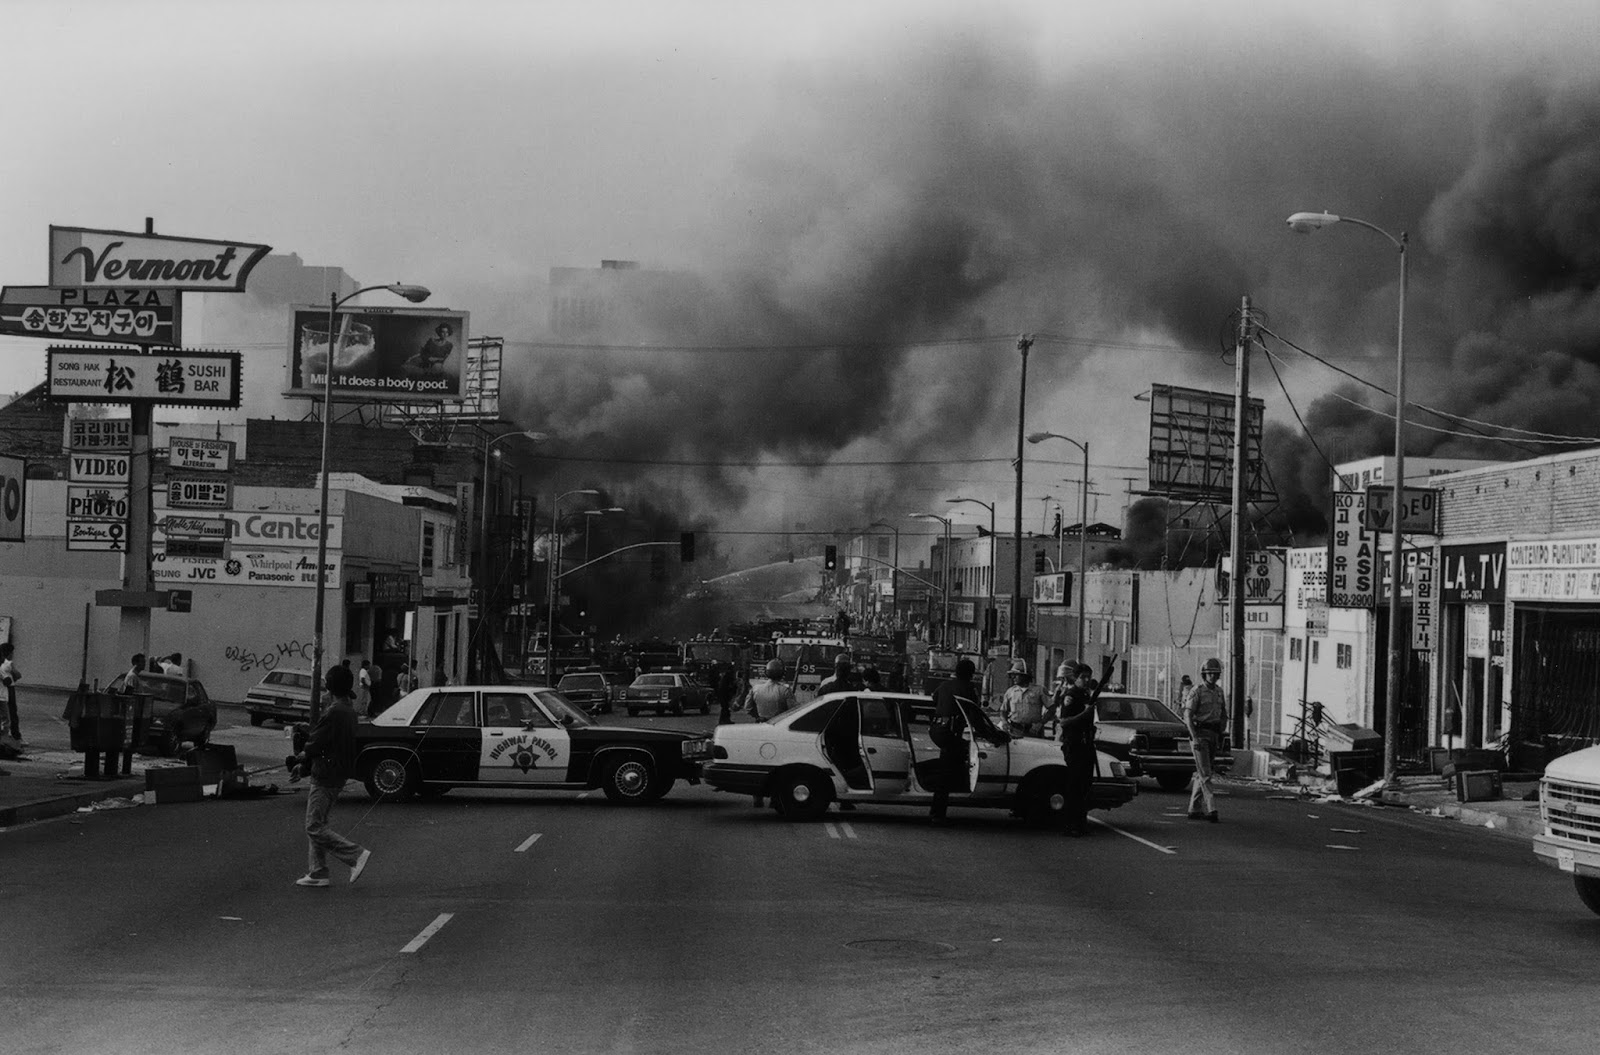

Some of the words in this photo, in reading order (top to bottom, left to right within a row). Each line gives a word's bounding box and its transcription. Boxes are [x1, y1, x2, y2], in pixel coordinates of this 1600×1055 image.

[61, 241, 236, 283] Vermont
[60, 289, 161, 305] PLAZA
[25, 309, 154, 332] 송학꼬치구이
[58, 362, 80, 371] SONG
[84, 363, 100, 371] HAK
[188, 364, 226, 378] SUSHI
[53, 378, 102, 387] RESTAURANT
[194, 380, 219, 392] BAR
[339, 375, 347, 385] It
[348, 376, 376, 387] does
[378, 378, 385, 387] a
[386, 377, 415, 391] body
[417, 379, 448, 392] good.
[73, 422, 130, 434] 코리아나
[73, 458, 127, 476] VIDEO
[184, 484, 226, 501] 이발관
[70, 497, 126, 516] PHOTO
[73, 525, 107, 540] Boutique
[204, 527, 225, 535] LOUNGE
[245, 515, 335, 540] Center
[1511, 545, 1549, 565] CONTEMPO
[1552, 543, 1597, 564] FURNITURE
[249, 558, 293, 571] Whirlpool
[1444, 555, 1467, 590] LA
[1479, 553, 1504, 590] TV
[188, 567, 216, 579] JVC
[248, 571, 295, 582] Panasonic
[1246, 577, 1271, 598] SHOP
[802, 664, 816, 674] 95
[490, 735, 528, 760] HIGHWAY
[531, 736, 558, 761] PATROL
